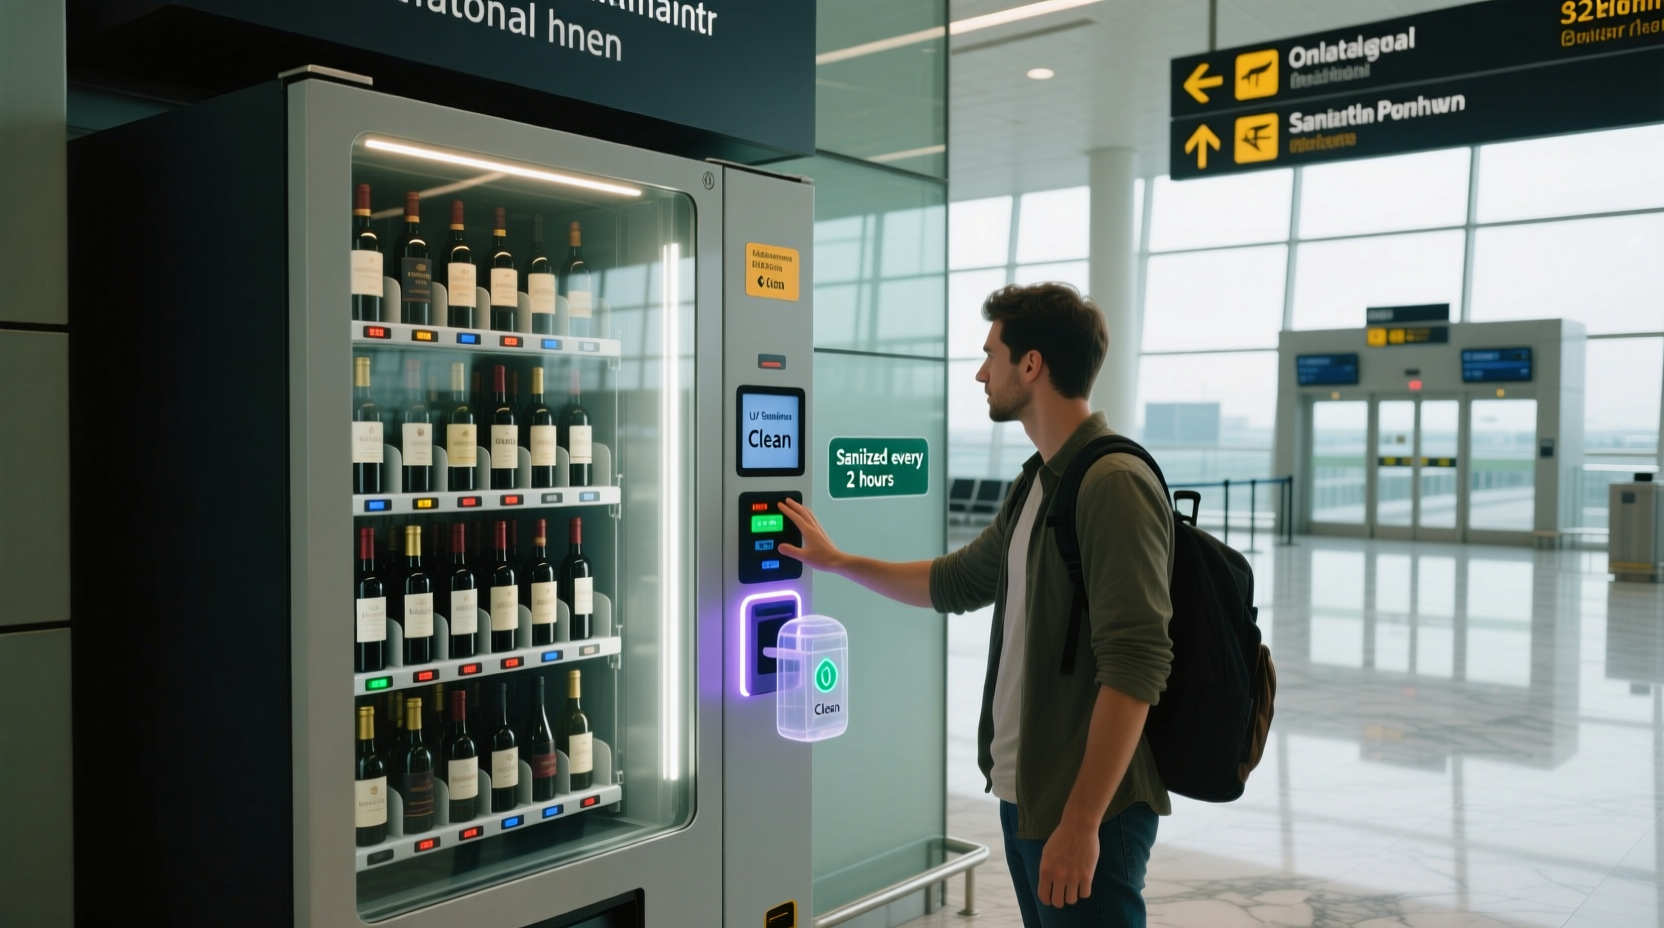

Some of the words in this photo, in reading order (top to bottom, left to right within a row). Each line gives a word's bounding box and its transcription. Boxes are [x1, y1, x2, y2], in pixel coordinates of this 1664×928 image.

[548, 8, 622, 62] hnen
[748, 428, 792, 449] Clean
[891, 452, 924, 470] every
[846, 470, 855, 488] 2
[859, 469, 895, 488] hours
